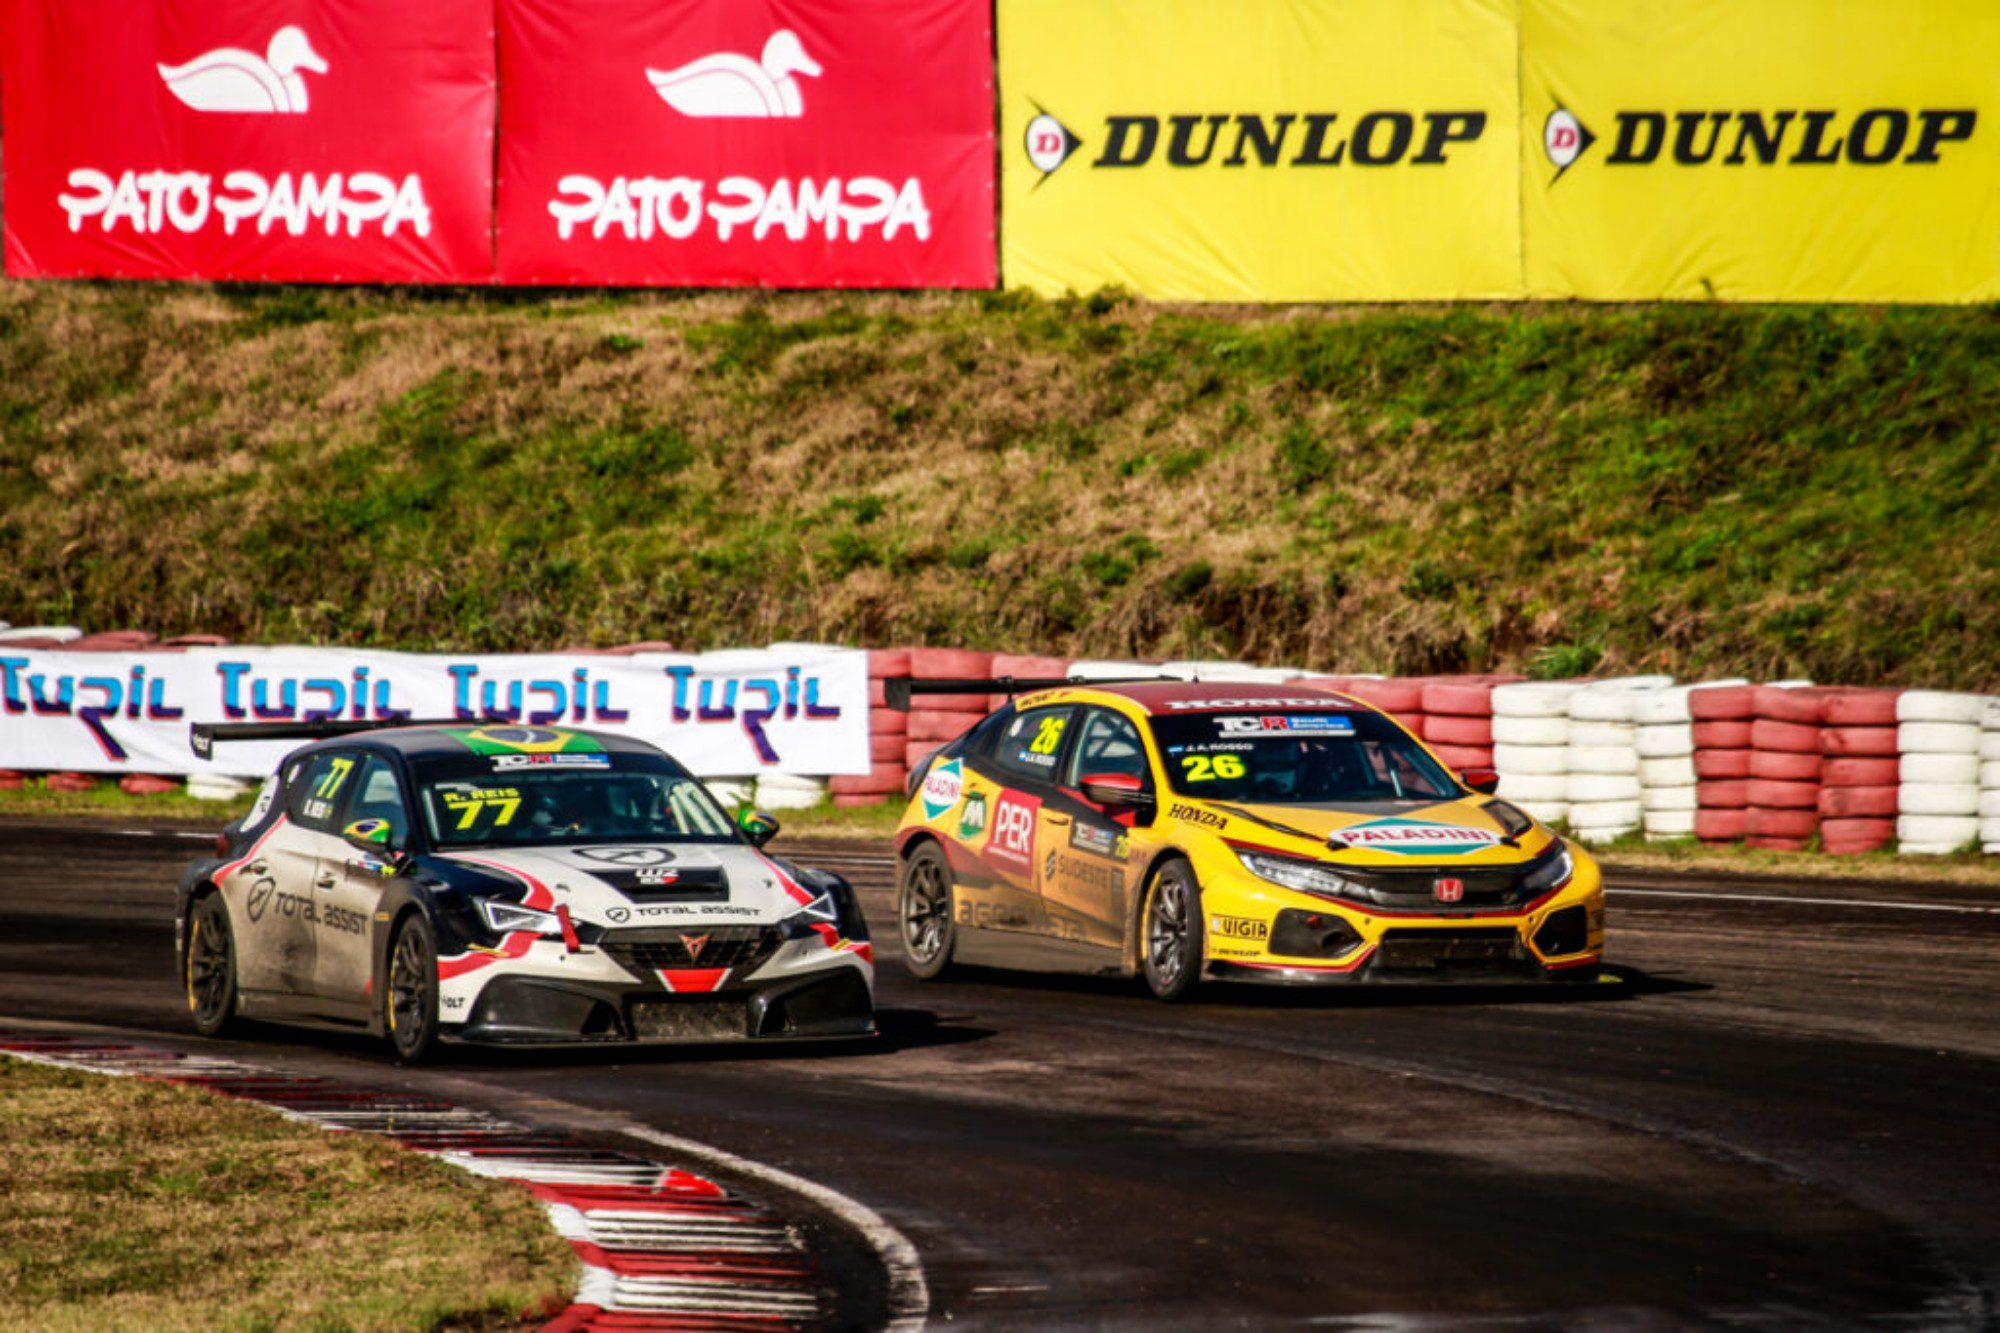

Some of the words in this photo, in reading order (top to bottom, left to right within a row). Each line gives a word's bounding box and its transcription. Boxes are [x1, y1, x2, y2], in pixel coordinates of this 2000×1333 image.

[1093, 112, 1487, 168] DUNLOP
[1605, 109, 1978, 166] DUNLOP
[58, 168, 211, 235] PATO
[214, 171, 431, 239] PAMPA
[547, 174, 704, 241] PATO
[706, 176, 931, 242] PAMPA
[1030, 716, 1065, 756] 26
[316, 757, 354, 799] 77
[1181, 755, 1245, 783] 26
[447, 798, 521, 831] 77
[995, 801, 1033, 855] PER
[1168, 803, 1228, 831] HONDA
[1341, 829, 1494, 842] PALADINI
